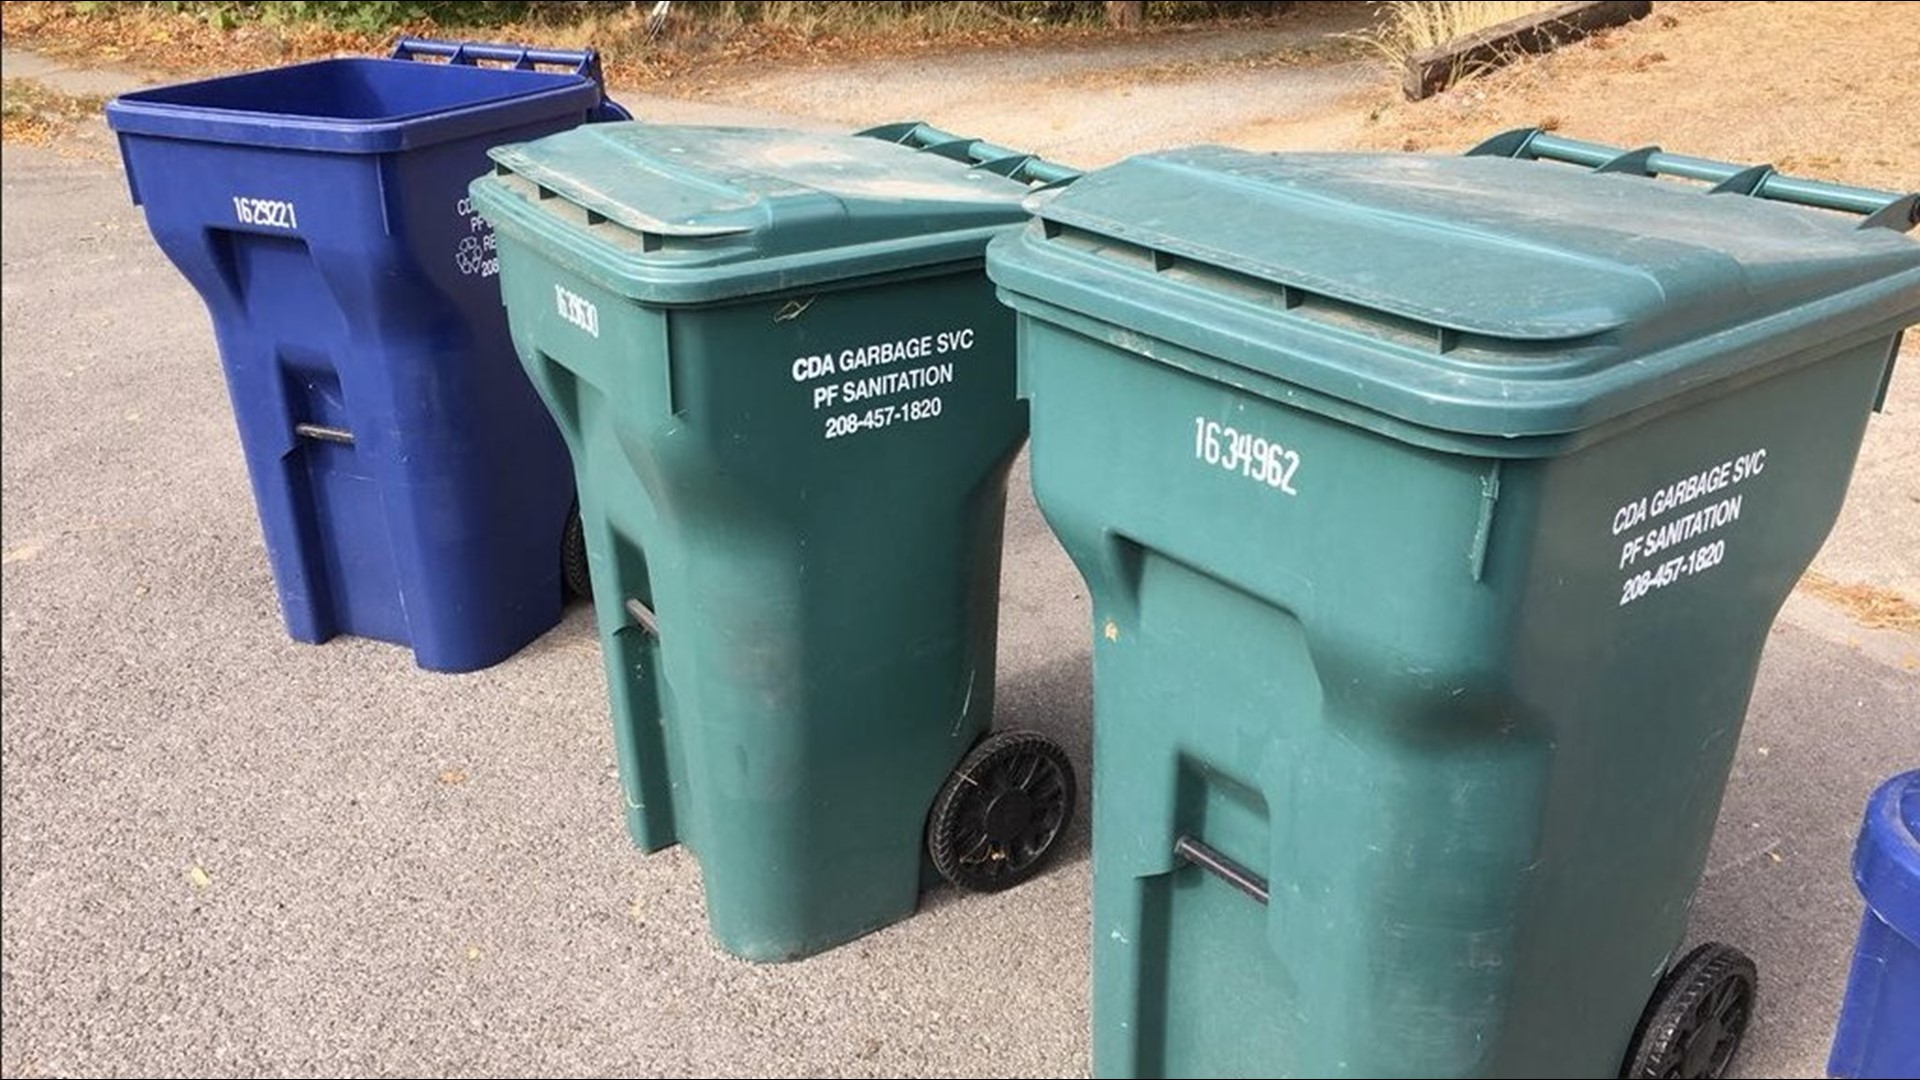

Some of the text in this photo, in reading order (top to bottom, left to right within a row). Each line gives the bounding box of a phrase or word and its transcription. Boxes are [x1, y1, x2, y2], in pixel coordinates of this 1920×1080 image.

[233, 196, 297, 228] 1629221
[792, 328, 974, 381] CDA GARBAGE SVC
[813, 363, 953, 409] PF SANITATION
[825, 397, 942, 438] 208-457-1820
[1195, 417, 1300, 496] 1634962
[1612, 448, 1766, 535] CDA GARBAGE SVC
[1619, 494, 1742, 570] PF SANITATION
[1619, 539, 1725, 606] 208-457-1820
